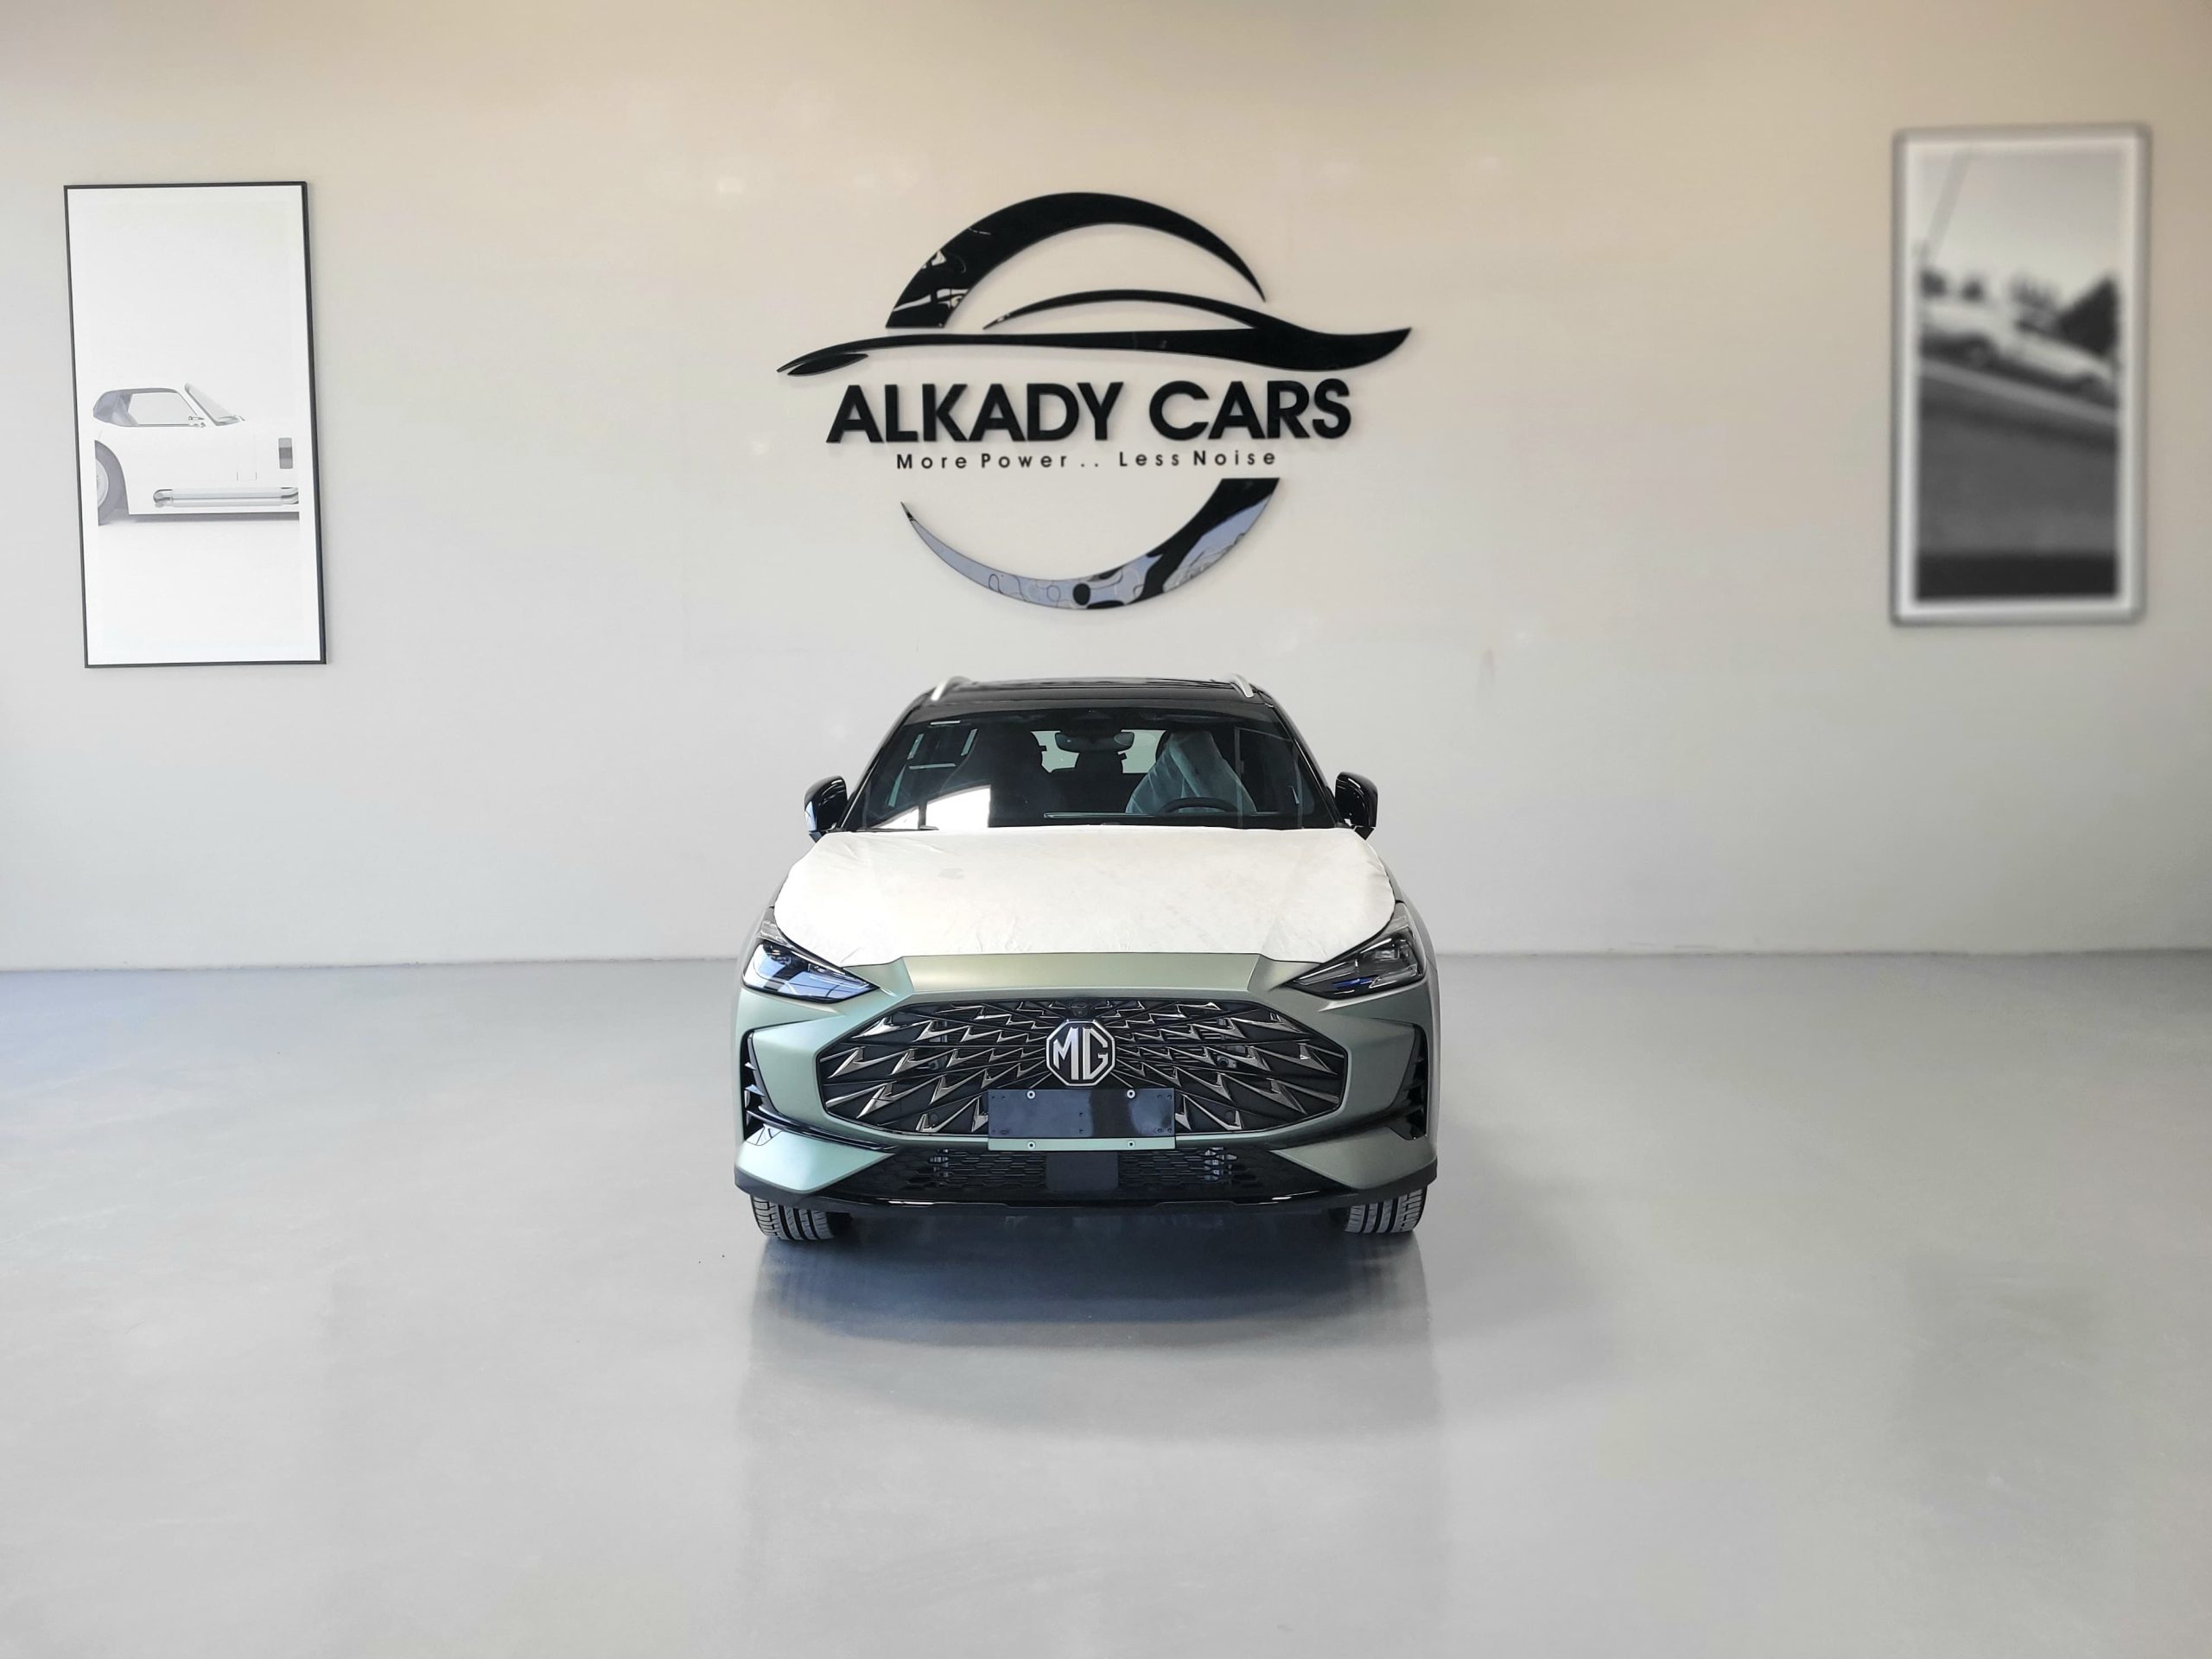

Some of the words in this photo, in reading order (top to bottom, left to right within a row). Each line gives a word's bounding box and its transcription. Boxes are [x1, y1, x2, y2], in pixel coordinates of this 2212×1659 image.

[825, 381, 1124, 443] ALKADY
[1149, 378, 1352, 442] CARS
[896, 453, 967, 469] More
[1119, 451, 1179, 467] Less
[1193, 450, 1275, 466] Noise
[1052, 1027, 1109, 1080] MG
